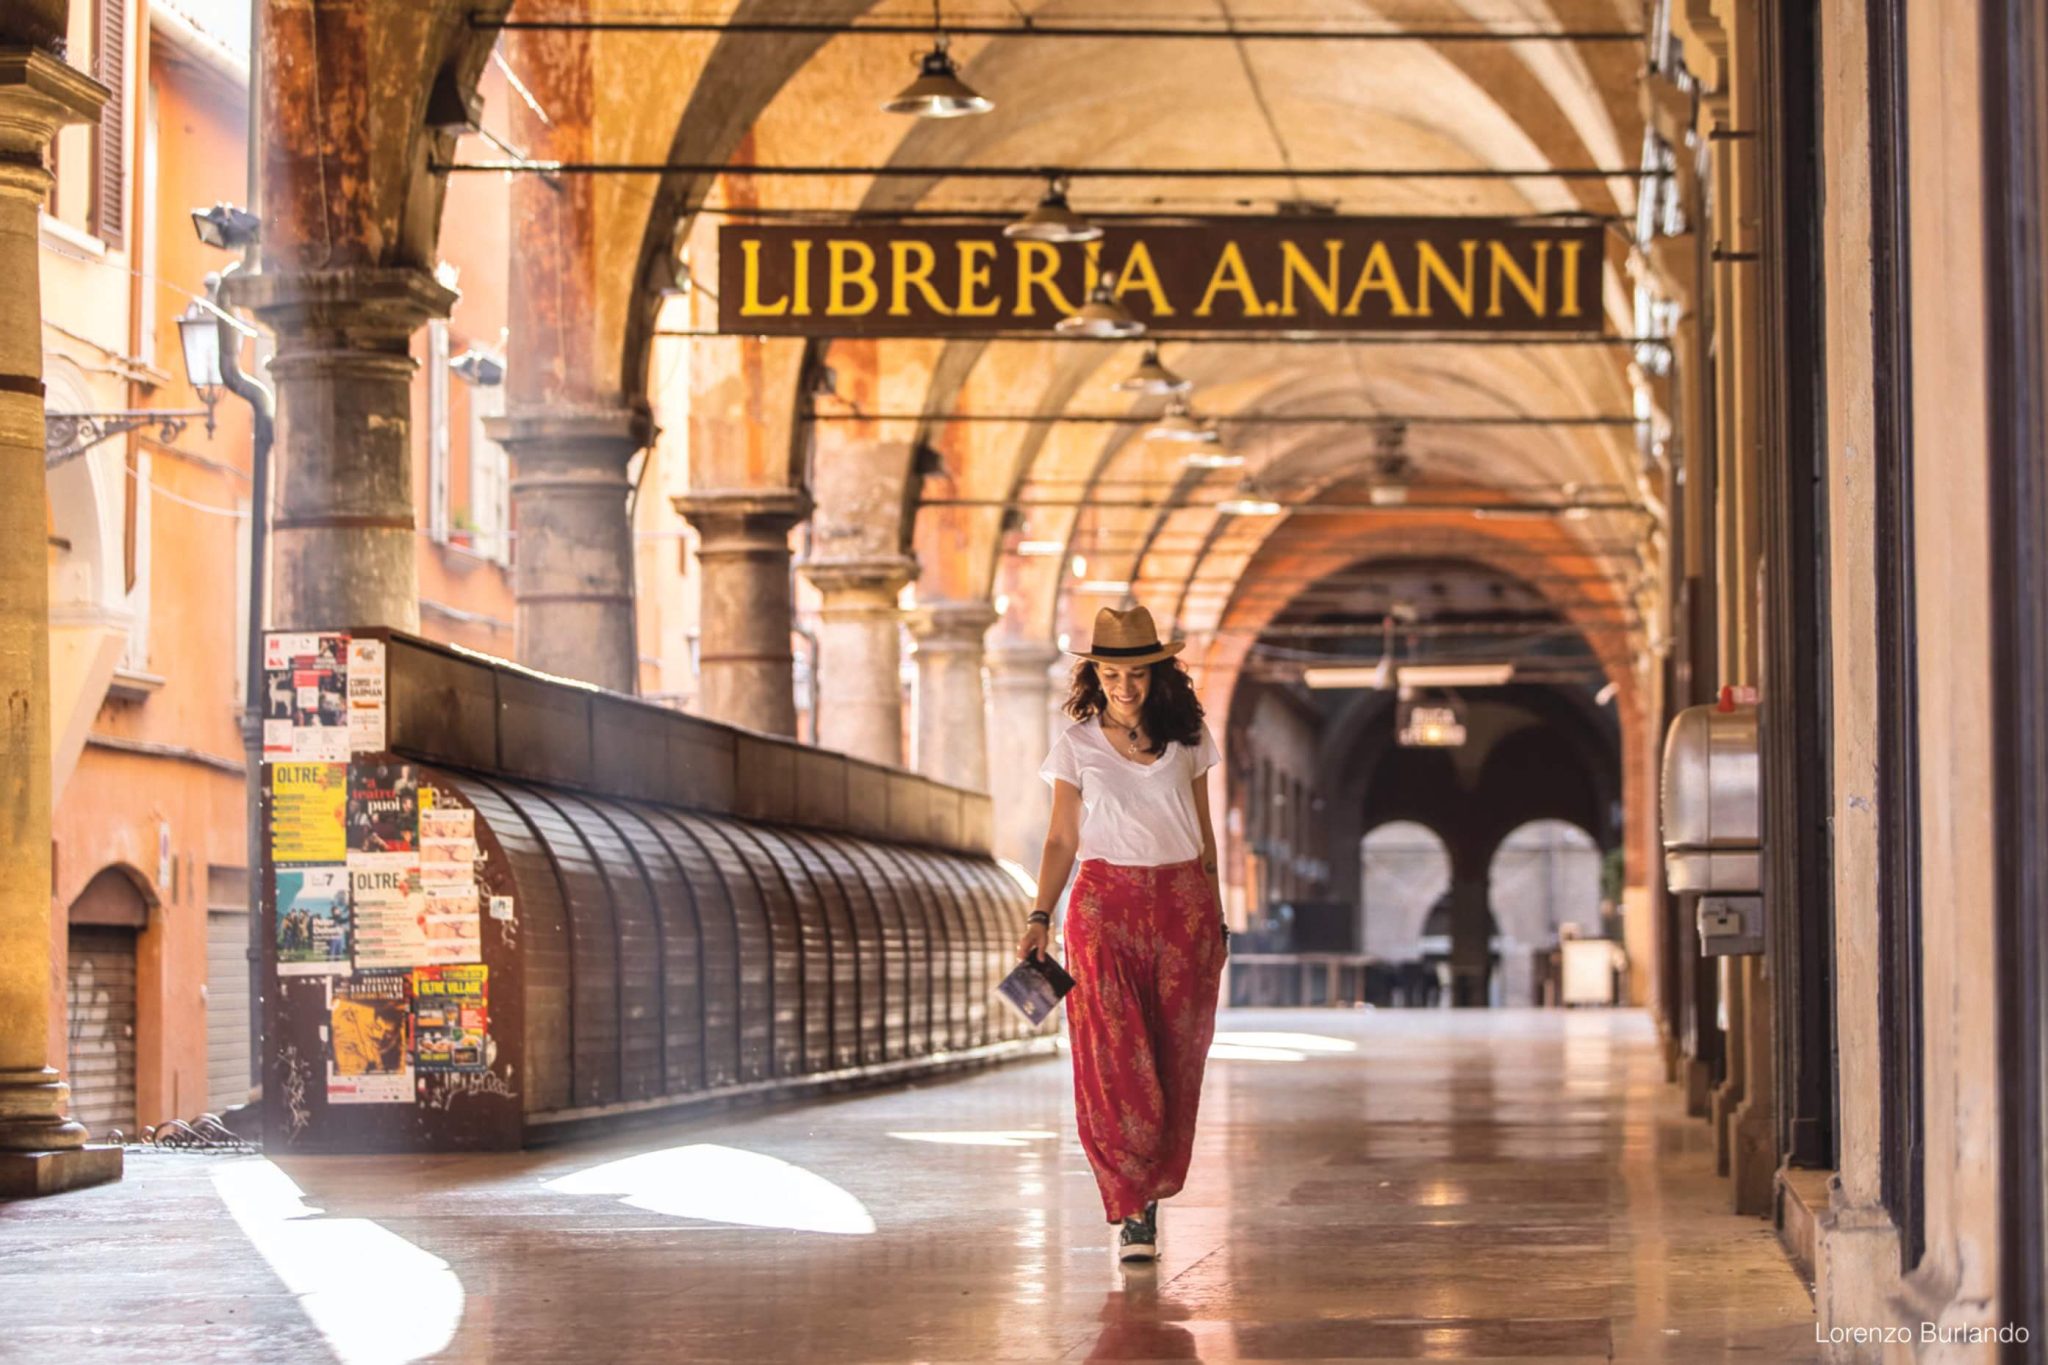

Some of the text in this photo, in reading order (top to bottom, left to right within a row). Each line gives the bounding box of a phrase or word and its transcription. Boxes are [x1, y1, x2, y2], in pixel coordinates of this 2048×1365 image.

[739, 239, 1175, 316] LIBRERIA
[276, 766, 319, 784] OLTRE
[367, 796, 400, 815] puoi
[356, 872, 401, 890] OLTRE
